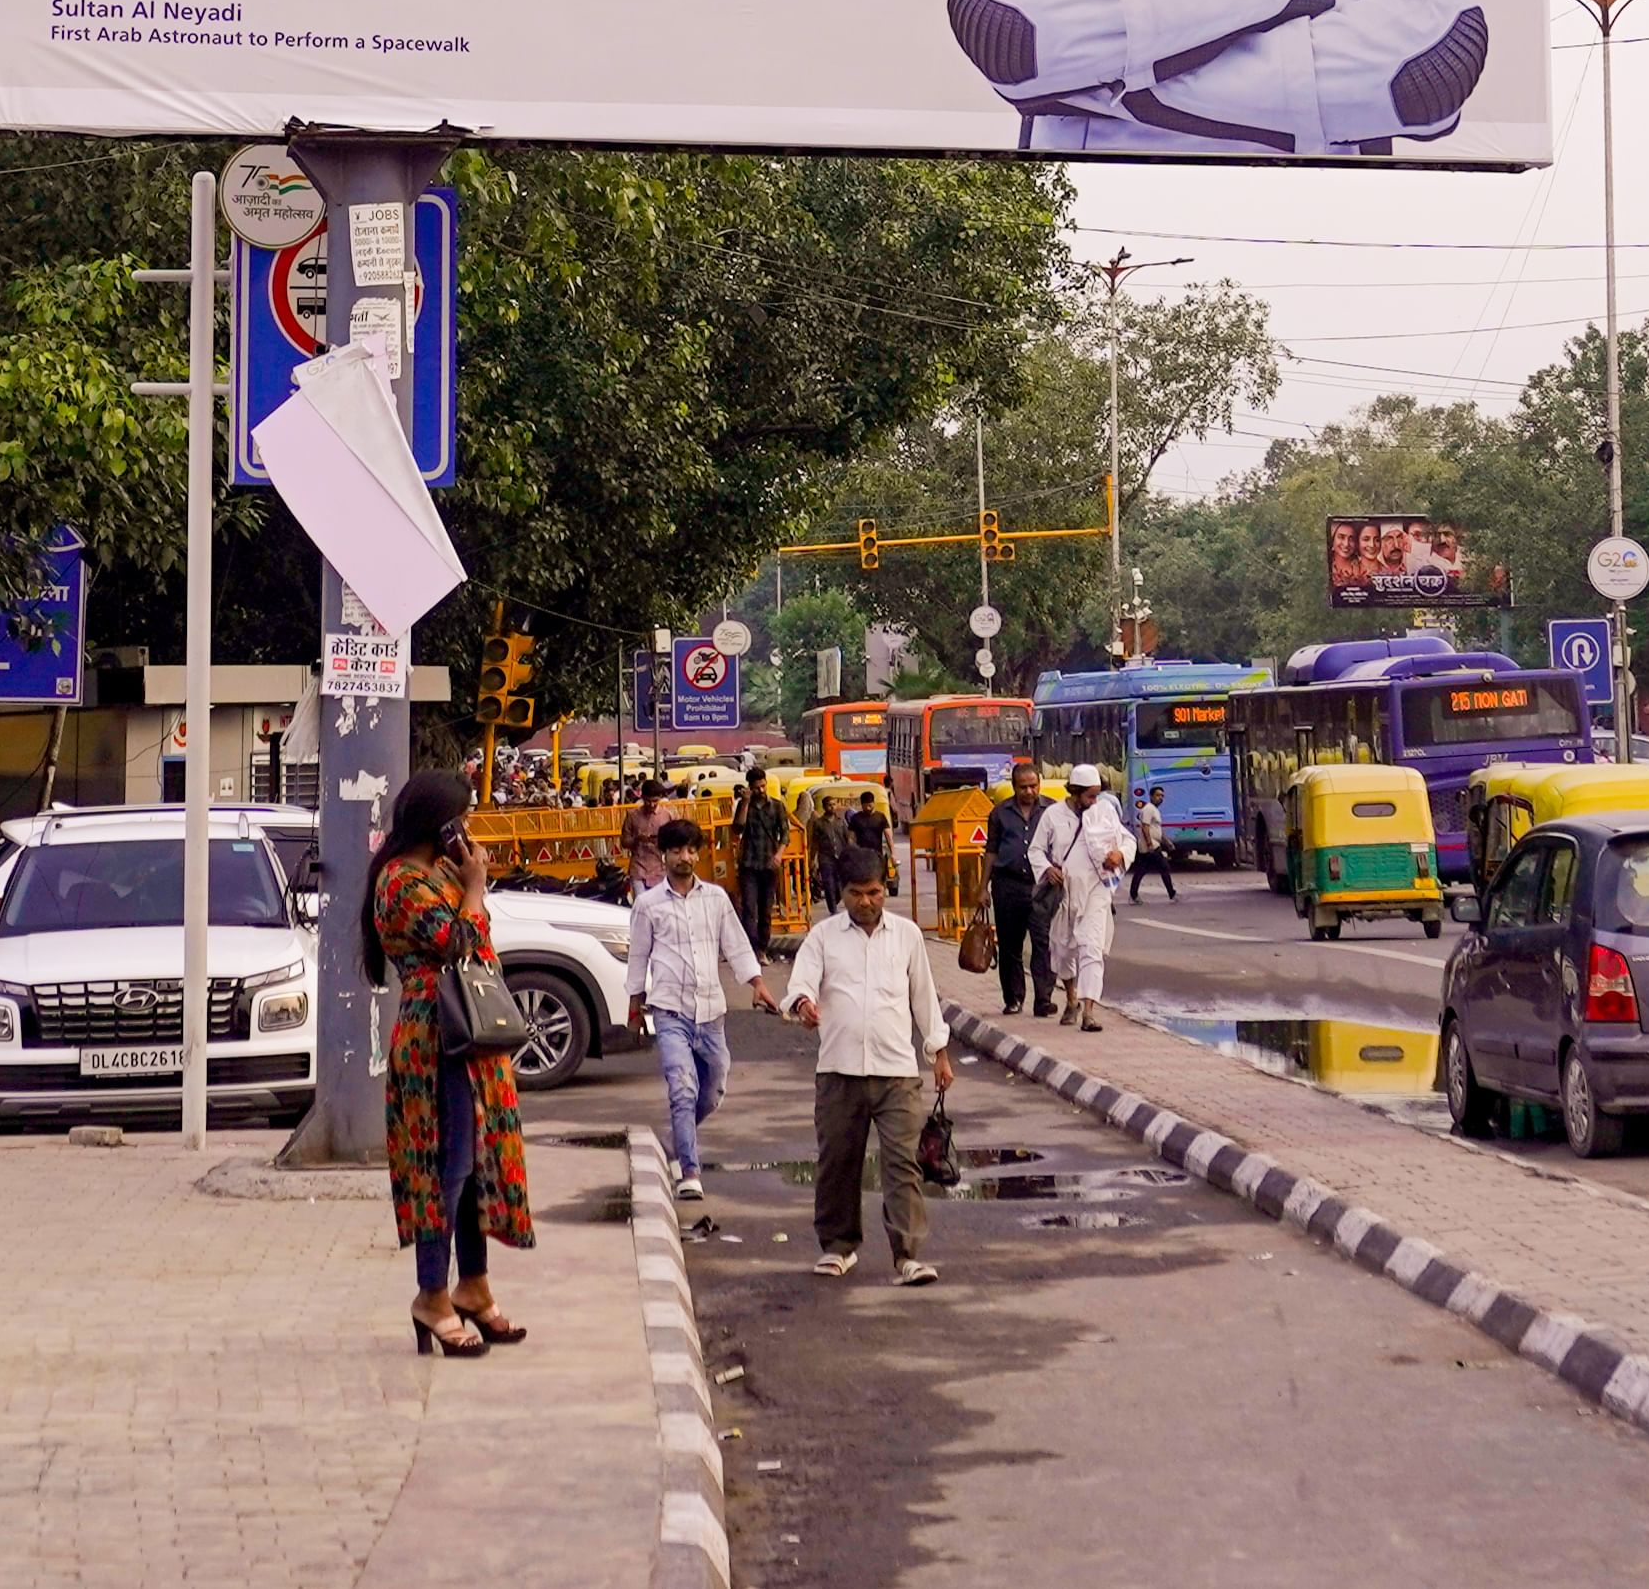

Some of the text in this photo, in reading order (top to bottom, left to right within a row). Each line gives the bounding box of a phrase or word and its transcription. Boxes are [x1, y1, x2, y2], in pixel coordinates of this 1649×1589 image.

[131, 0, 156, 20] Al
[163, 2, 242, 26] Neyadi
[51, 24, 471, 54] First Arab Astronaut to Perform a Spacewalk
[243, 205, 315, 222] अमृत महोत्सव
[368, 209, 400, 221] JOBS
[1174, 706, 1191, 724] 901
